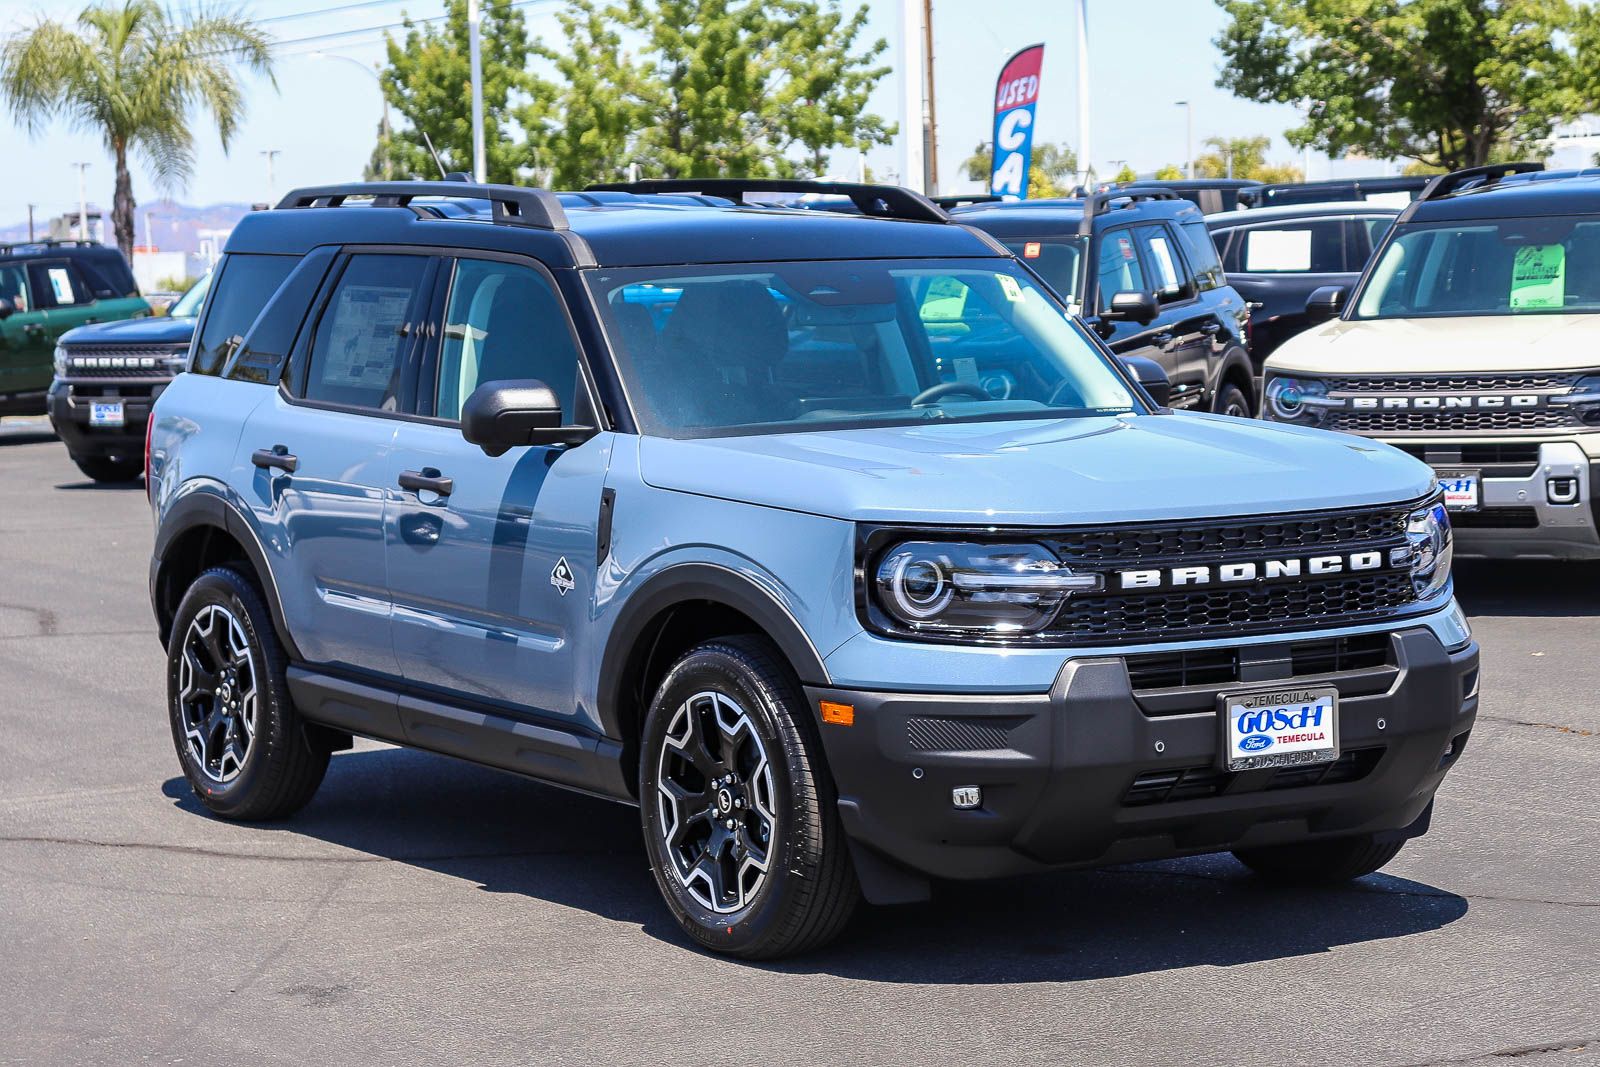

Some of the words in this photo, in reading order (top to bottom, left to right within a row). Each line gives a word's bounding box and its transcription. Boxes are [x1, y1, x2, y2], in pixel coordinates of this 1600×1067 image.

[998, 75, 1038, 107] USED
[992, 109, 1032, 200] CA
[73, 358, 155, 368] BRONCO
[1353, 395, 1538, 408] BRONCO
[1121, 551, 1381, 589] BRONCO
[1252, 692, 1310, 706] TEMECULA
[1277, 732, 1325, 744] TEMECULA
